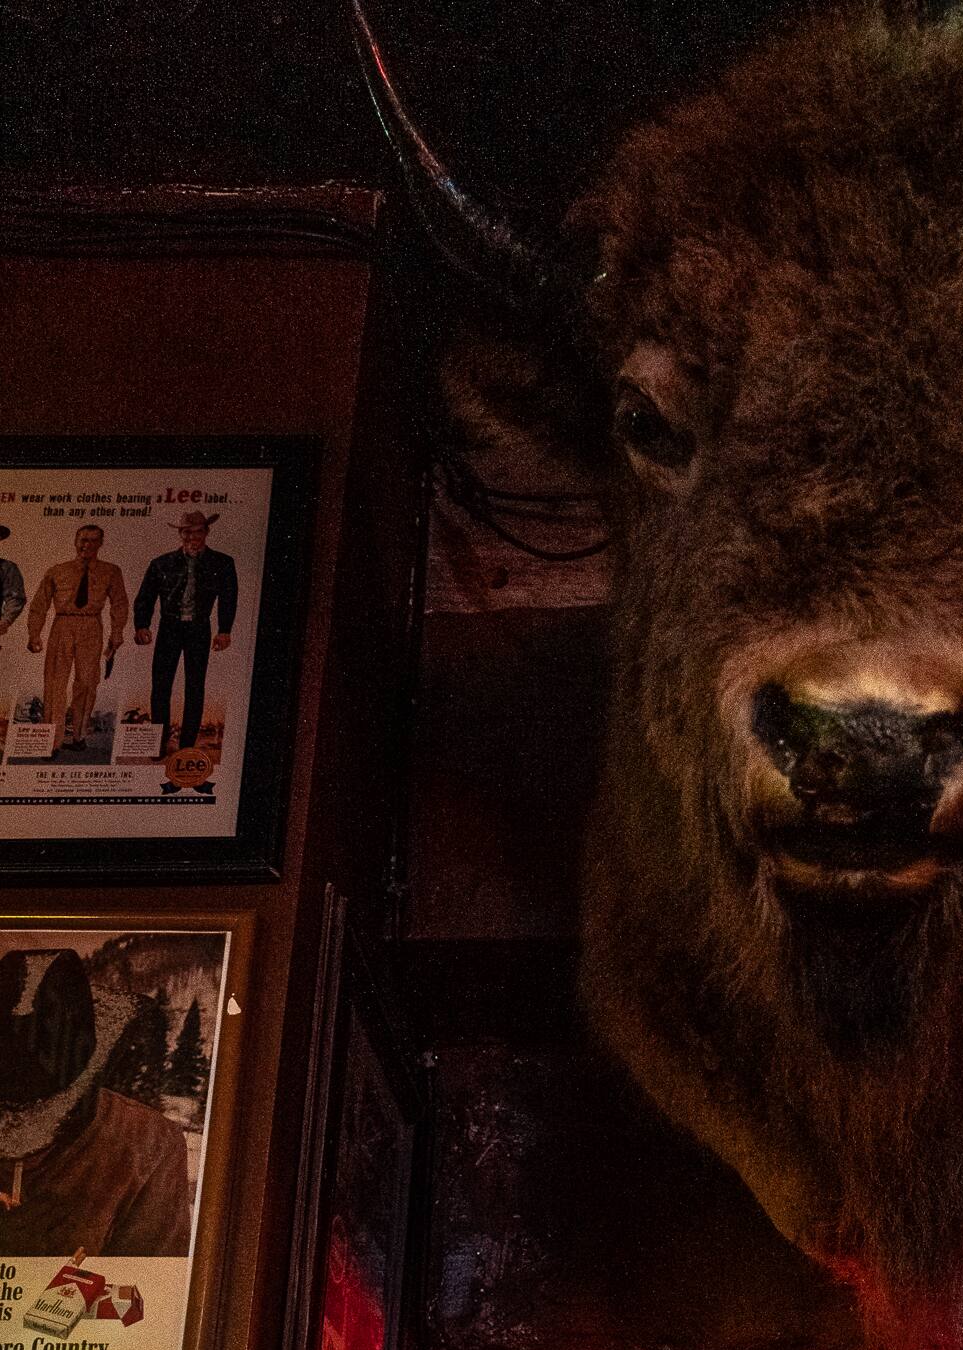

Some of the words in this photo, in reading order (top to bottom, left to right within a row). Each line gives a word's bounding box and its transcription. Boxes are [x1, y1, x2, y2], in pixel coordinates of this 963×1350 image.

[22, 494, 45, 503] wear
[49, 492, 72, 503] work
[76, 492, 112, 503] clothes
[116, 492, 152, 506] bearing
[156, 494, 162, 503] a
[164, 487, 203, 503] Lee
[43, 505, 65, 517] than
[68, 508, 86, 519] any
[90, 506, 116, 517] other
[120, 505, 152, 517] brand!
[175, 758, 206, 772] Lee
[0, 1263, 16, 1280] to
[35, 1298, 74, 1319] Marlboro
